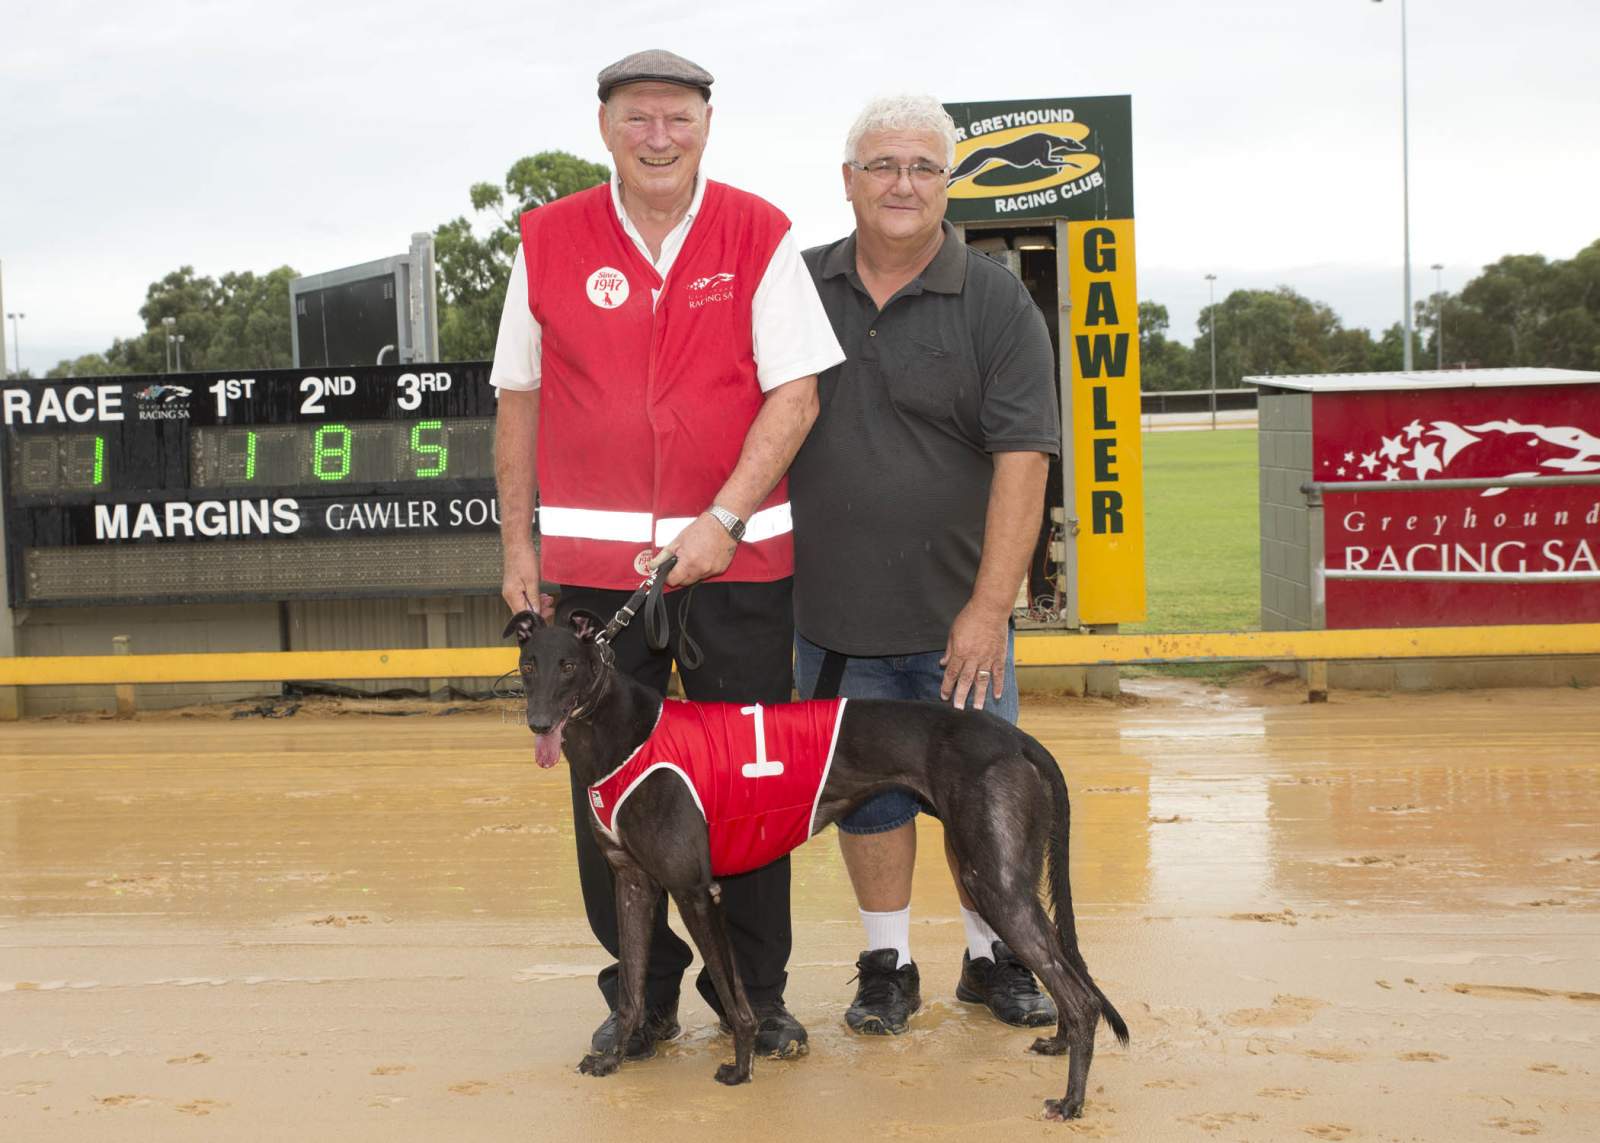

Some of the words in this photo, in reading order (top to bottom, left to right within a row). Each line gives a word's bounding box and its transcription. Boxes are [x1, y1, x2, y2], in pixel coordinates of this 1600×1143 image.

[970, 109, 1074, 136] GREYHOUND
[995, 189, 1058, 213] RACING
[1061, 171, 1103, 196] CLUB
[593, 279, 624, 291] 1947
[598, 271, 618, 279] Since
[209, 379, 256, 417] 1ST
[300, 376, 356, 414] 2ND
[397, 372, 452, 410] 3RD
[1075, 227, 1129, 535] GAWLER
[3, 385, 125, 425] RACE
[139, 410, 177, 420] RACING
[177, 409, 191, 419] SA
[93, 436, 104, 485] 1
[246, 431, 256, 481] 1
[313, 424, 352, 481] 8
[411, 420, 448, 477] 5
[95, 498, 301, 540] MARGINS
[325, 499, 439, 531] GAWLER
[1344, 503, 1600, 536] Greyhound
[1345, 541, 1527, 574] RACING
[1541, 538, 1600, 574] SA
[740, 702, 784, 778] 1
